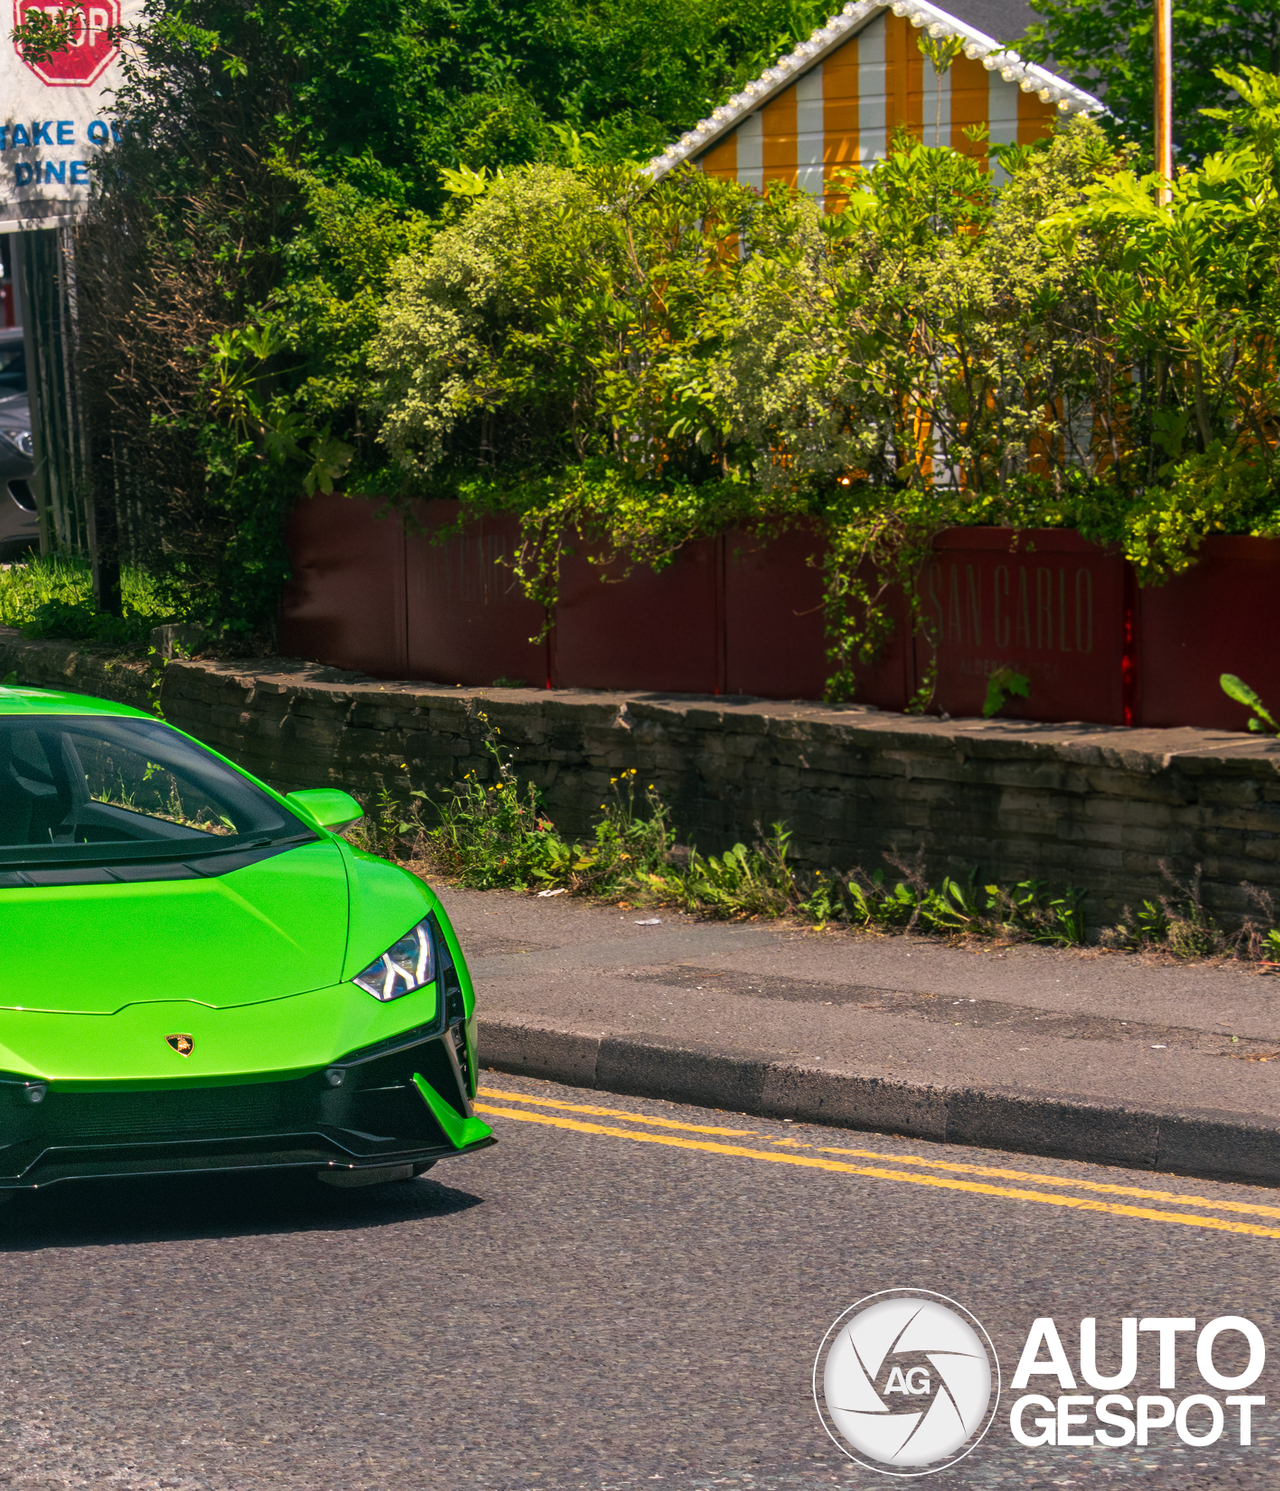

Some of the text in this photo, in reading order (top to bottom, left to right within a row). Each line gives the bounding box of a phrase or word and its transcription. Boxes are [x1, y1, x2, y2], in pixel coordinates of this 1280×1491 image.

[14, 160, 90, 187] DINE
[928, 562, 1093, 654] SAN CARLO
